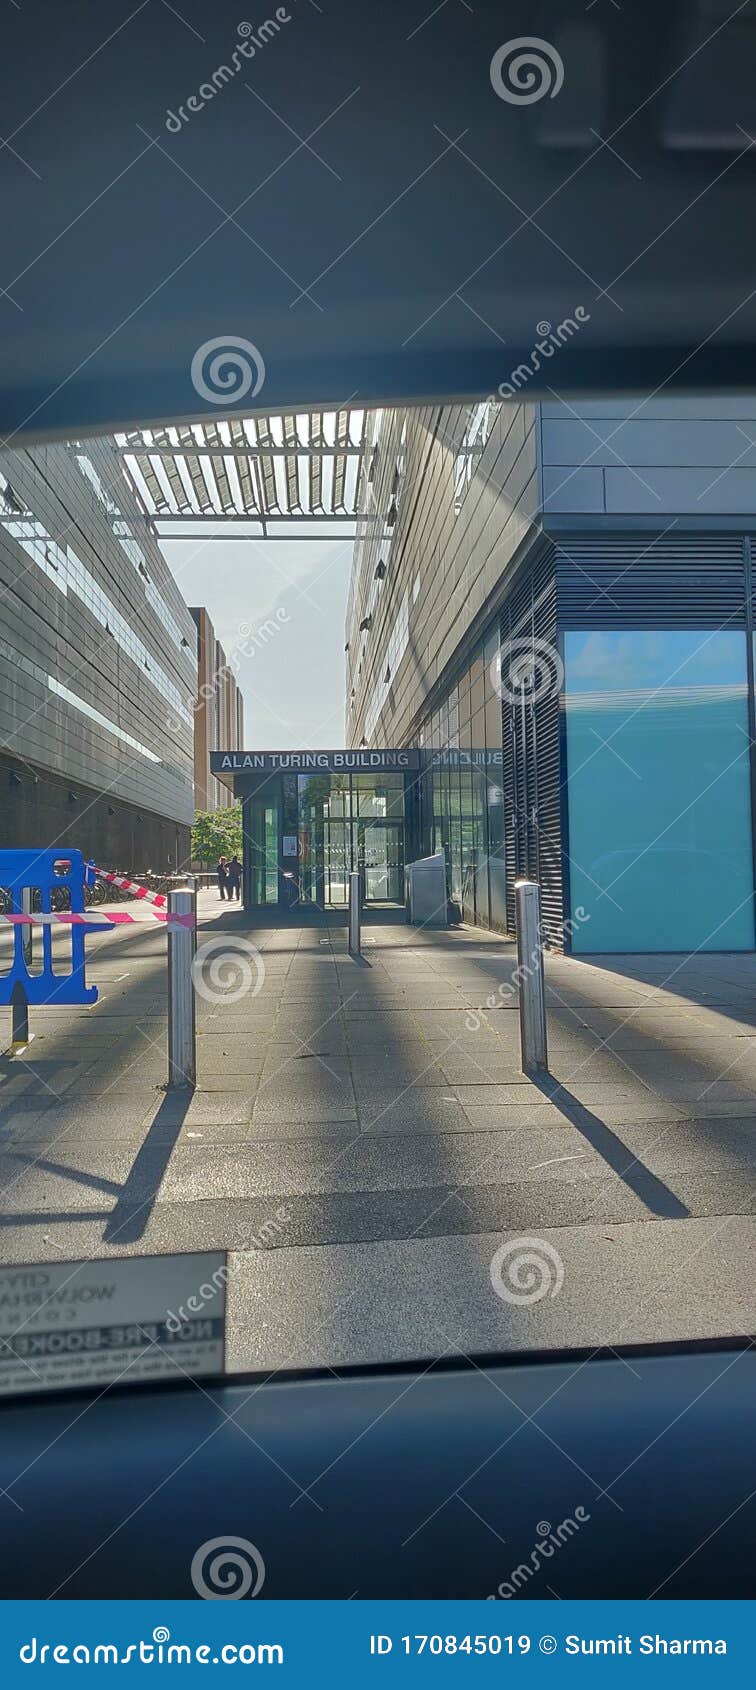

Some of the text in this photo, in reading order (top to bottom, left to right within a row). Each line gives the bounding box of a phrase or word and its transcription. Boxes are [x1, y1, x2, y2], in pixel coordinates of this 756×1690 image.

[221, 753, 409, 768] ALAN TURING BUILDING
